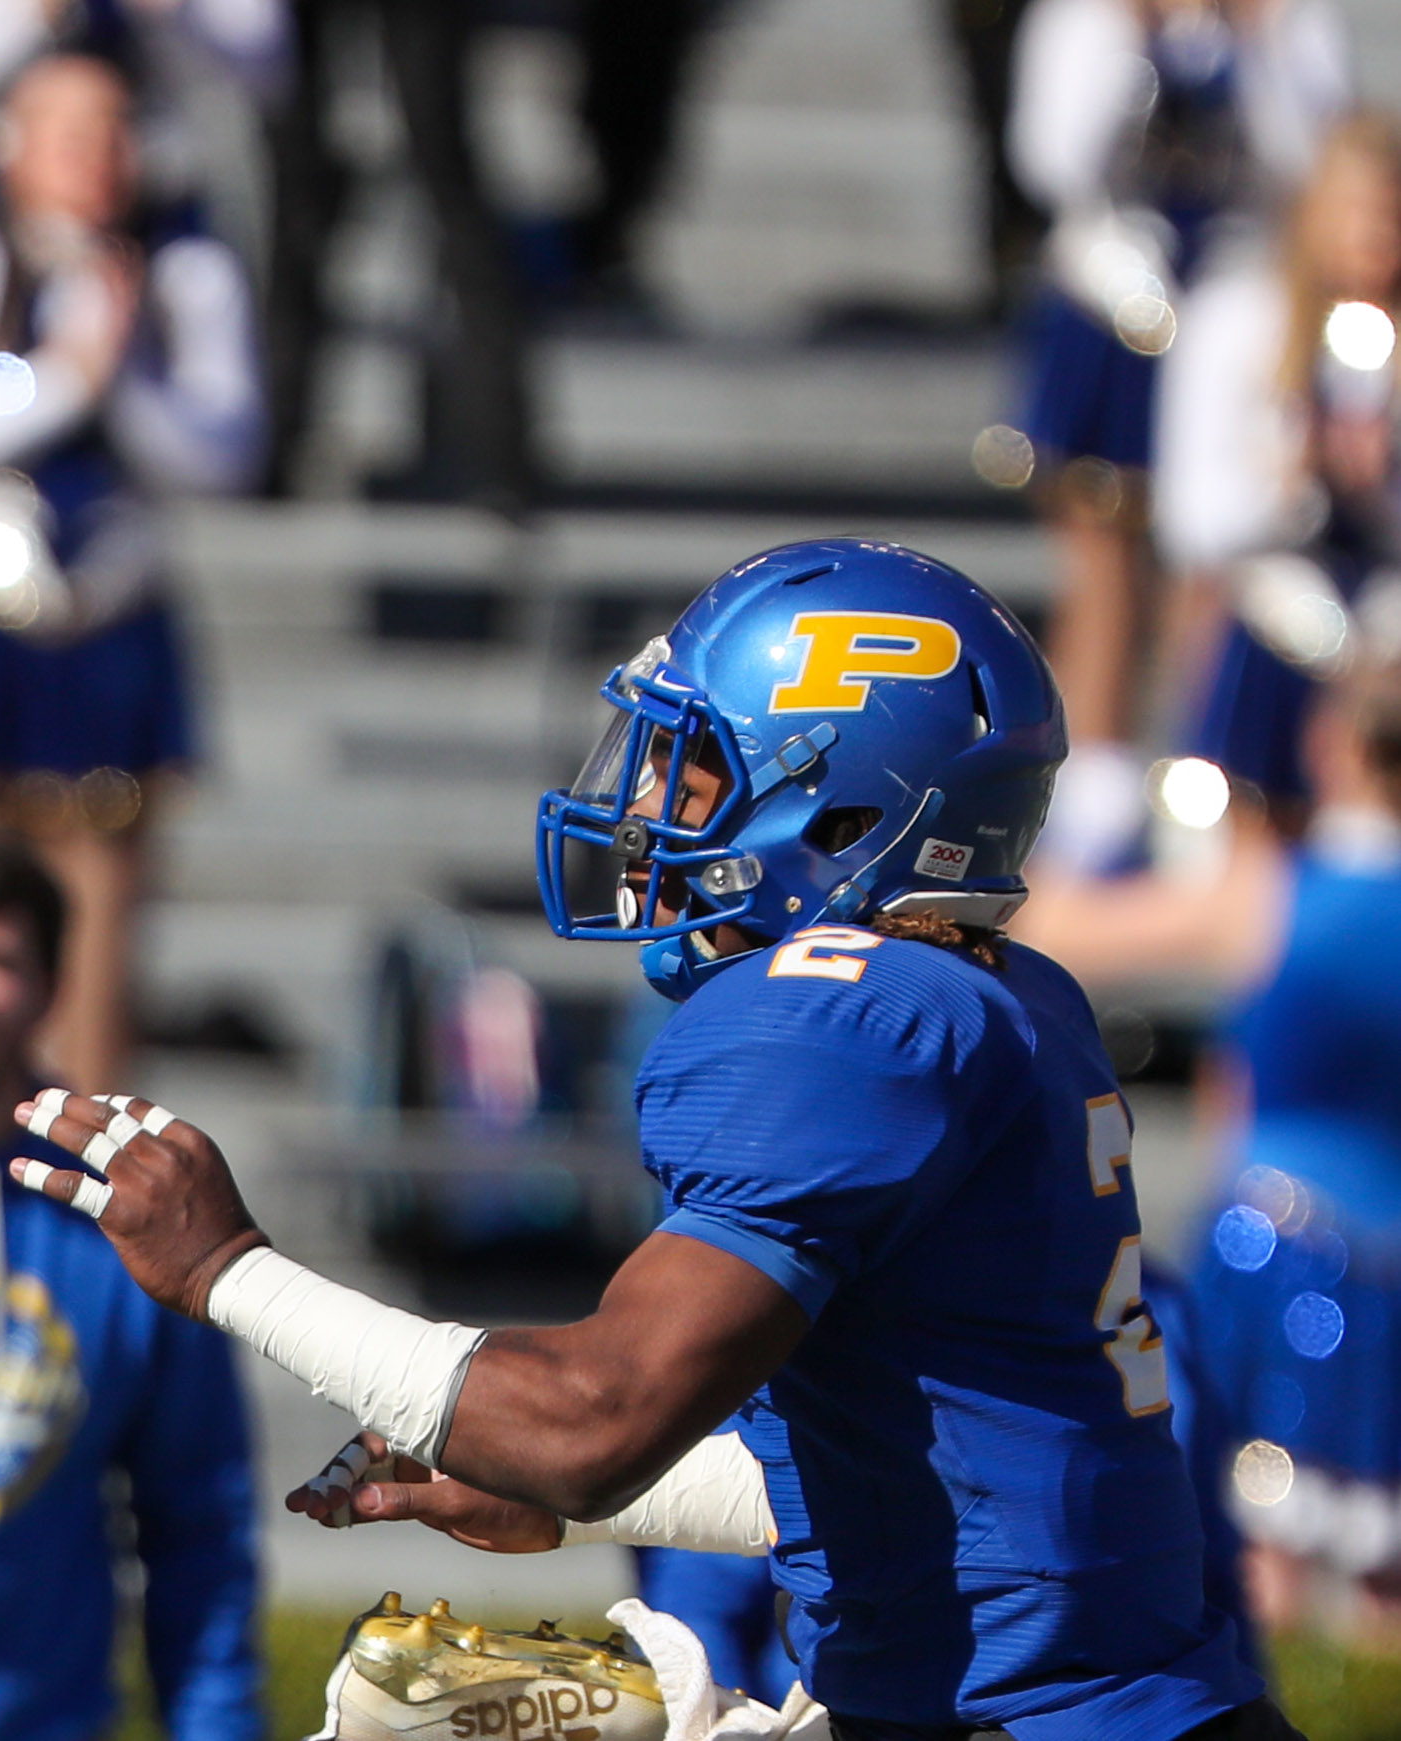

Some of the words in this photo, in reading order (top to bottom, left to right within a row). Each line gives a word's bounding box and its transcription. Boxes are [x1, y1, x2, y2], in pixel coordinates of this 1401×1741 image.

[768, 611, 962, 714] P
[929, 845, 966, 864] 200
[767, 925, 884, 982] 2
[450, 1682, 620, 1741] adidas
